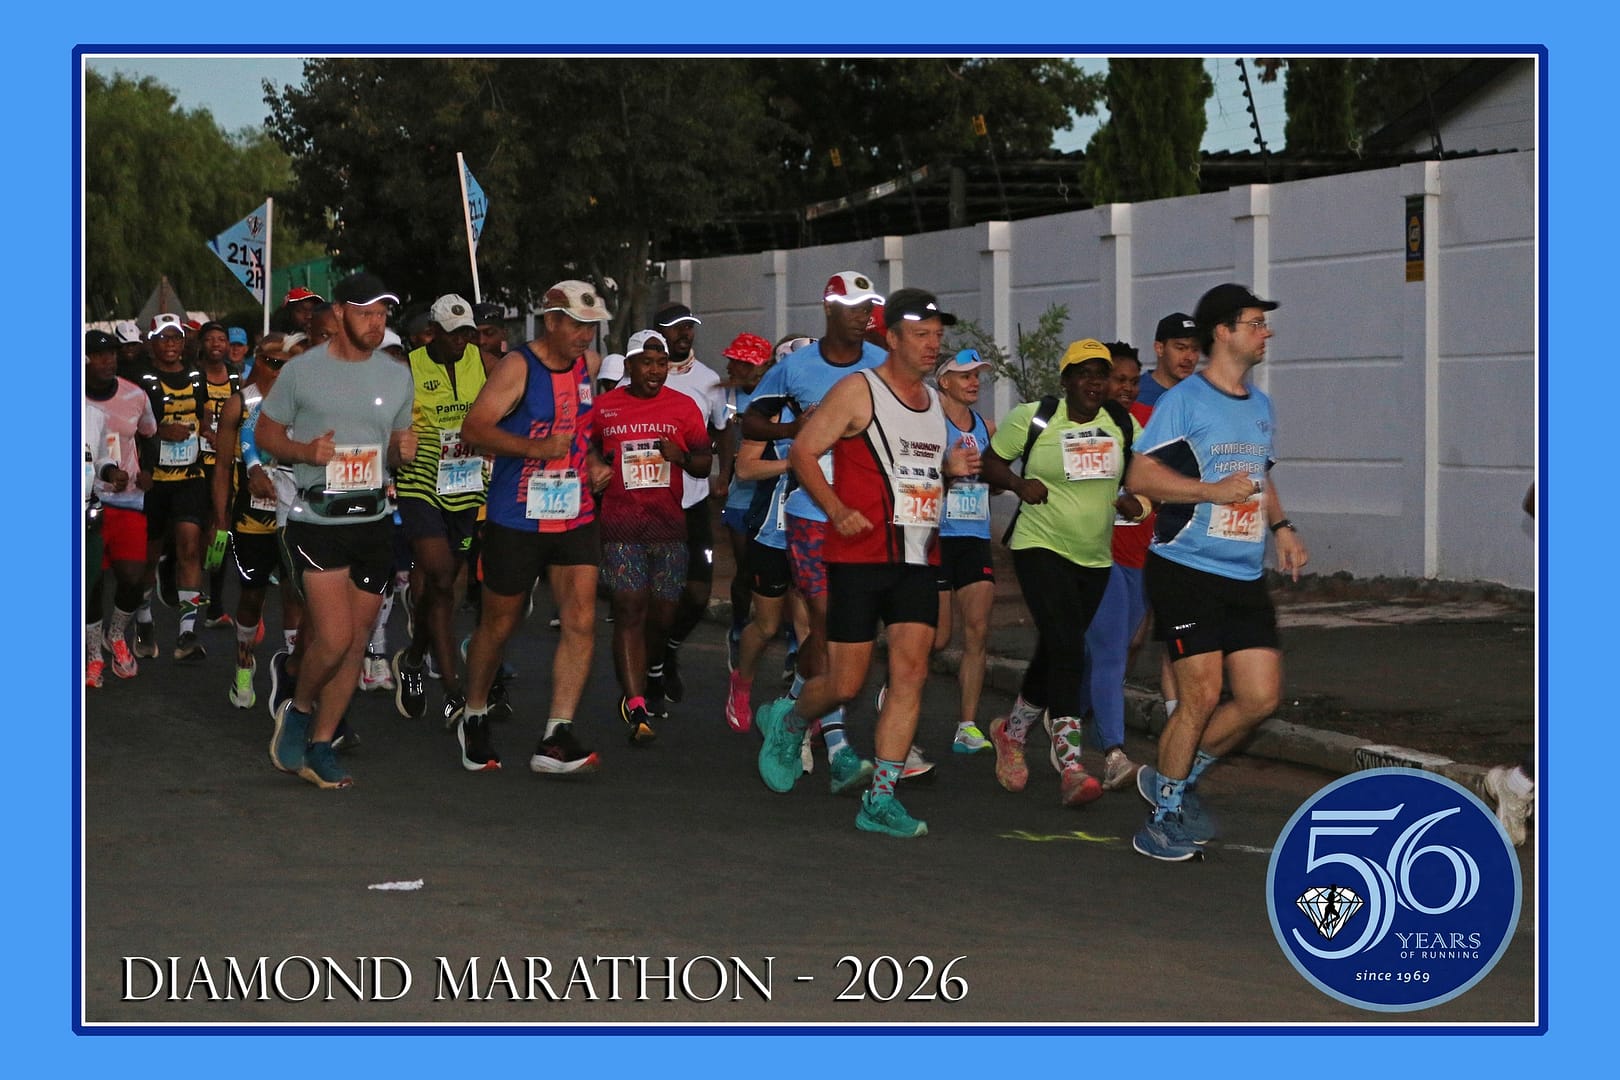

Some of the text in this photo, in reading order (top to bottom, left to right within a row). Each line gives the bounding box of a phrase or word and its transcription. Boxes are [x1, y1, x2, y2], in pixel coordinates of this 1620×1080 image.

[227, 242, 263, 268] 21.1
[603, 423, 678, 437] TEAM VITALITY
[910, 441, 941, 453] HARMONY
[335, 461, 374, 482] 2136
[1072, 453, 1112, 472] 2058
[630, 463, 663, 482] 2107
[1219, 509, 1258, 532] 2142
